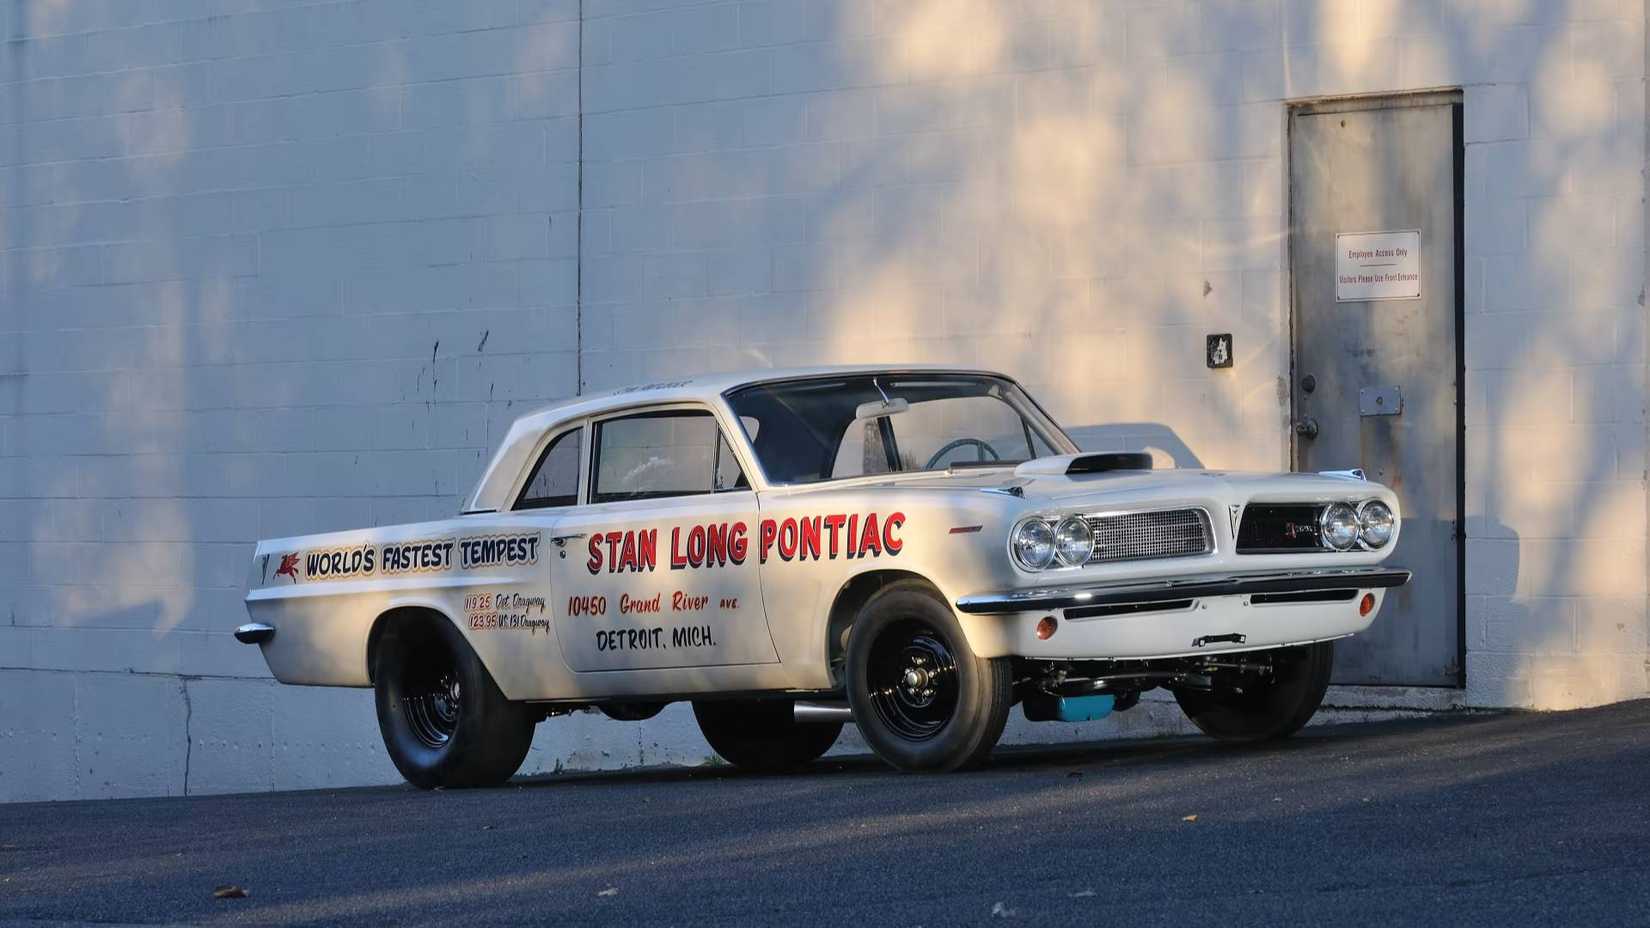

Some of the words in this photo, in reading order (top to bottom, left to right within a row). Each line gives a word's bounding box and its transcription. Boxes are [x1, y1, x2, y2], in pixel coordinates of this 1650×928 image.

[1348, 250, 1373, 260] Employee
[1375, 249, 1394, 257] Access
[1396, 248, 1407, 257] Only
[1358, 274, 1374, 283] Please
[1375, 273, 1384, 282] Use
[587, 528, 659, 575] STAN
[670, 521, 749, 570] LONG
[759, 511, 906, 564] PONTIAC
[306, 544, 375, 577] WORLD'S
[382, 542, 454, 570] FASTEST
[461, 536, 539, 566] TEMPEST
[568, 596, 607, 617] 10450
[620, 592, 662, 615] Grand
[672, 590, 710, 611] River
[673, 624, 717, 648] MICH.
